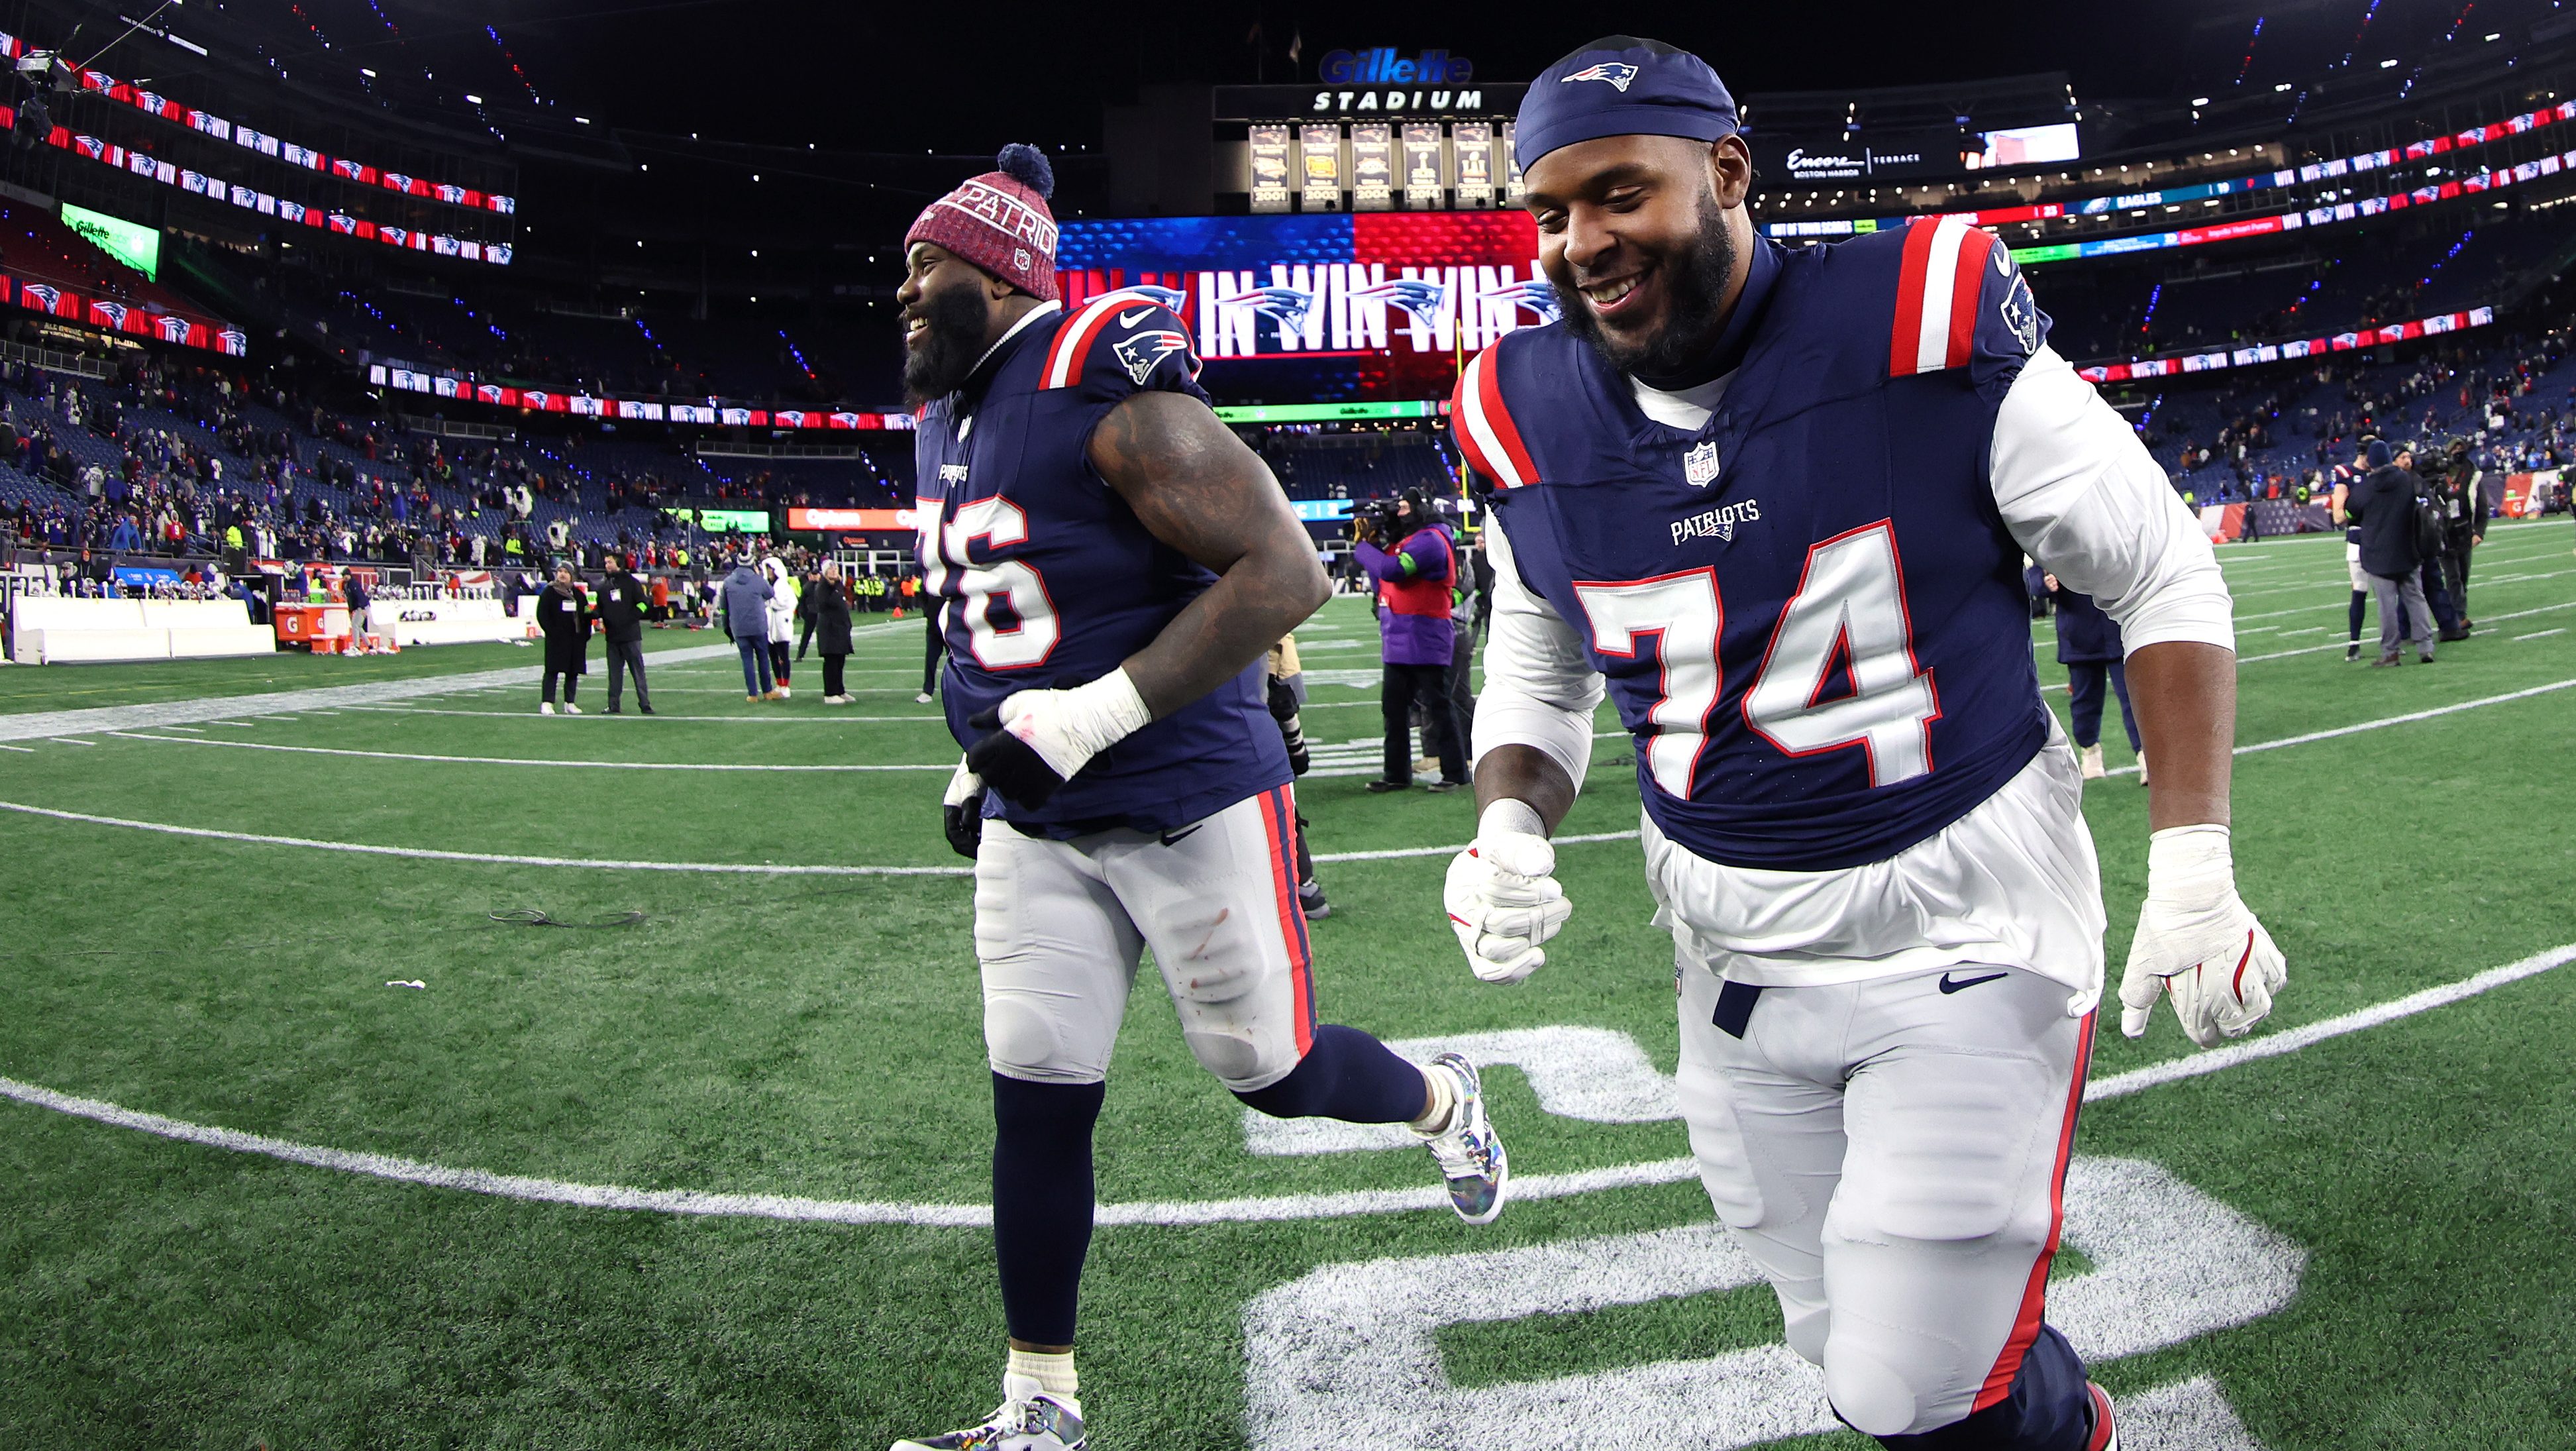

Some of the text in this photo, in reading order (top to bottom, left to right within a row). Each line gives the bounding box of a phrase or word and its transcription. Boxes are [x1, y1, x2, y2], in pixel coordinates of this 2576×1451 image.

[1319, 47, 1472, 84] Gillette
[1313, 90, 1481, 111] STADIUM
[211, 117, 231, 141] WIN
[261, 134, 278, 157] WIN
[1787, 148, 1920, 170] Encore TERRACE
[1794, 169, 1859, 179] BOSTON HARBOR
[2274, 169, 2295, 188] WIN
[2328, 159, 2347, 177] WIN
[1256, 192, 1286, 201] 2001
[1306, 191, 1337, 199] 2003
[1357, 189, 1388, 199] 2004
[1409, 189, 1439, 198] 2014
[1461, 189, 1490, 197] 2016
[2117, 191, 2162, 209] EAGLES
[2282, 213, 2302, 231] WIN
[2335, 202, 2355, 221] WIN
[2540, 155, 2560, 176] WIN
[157, 160, 176, 186] WIN
[208, 177, 226, 201] WIN
[258, 192, 275, 215] WIN
[461, 240, 480, 261] WIN
[76, 220, 109, 239] Gillette
[1822, 221, 1853, 234] SCORES
[1271, 264, 1388, 351] WIN
[1402, 265, 1517, 352] WIN
[2208, 352, 2227, 368] WIN
[2259, 345, 2277, 361] WIN
[370, 364, 386, 386] WIN
[414, 372, 429, 394] WIN
[644, 403, 662, 421] WIN
[696, 406, 715, 424] WIN
[1691, 460, 1714, 479] NFL
[805, 508, 861, 528] Optum
[1671, 499, 1760, 546] PATRIOTS
[915, 494, 1061, 672] 76
[287, 616, 297, 633] G
[1571, 517, 1943, 801] 74
